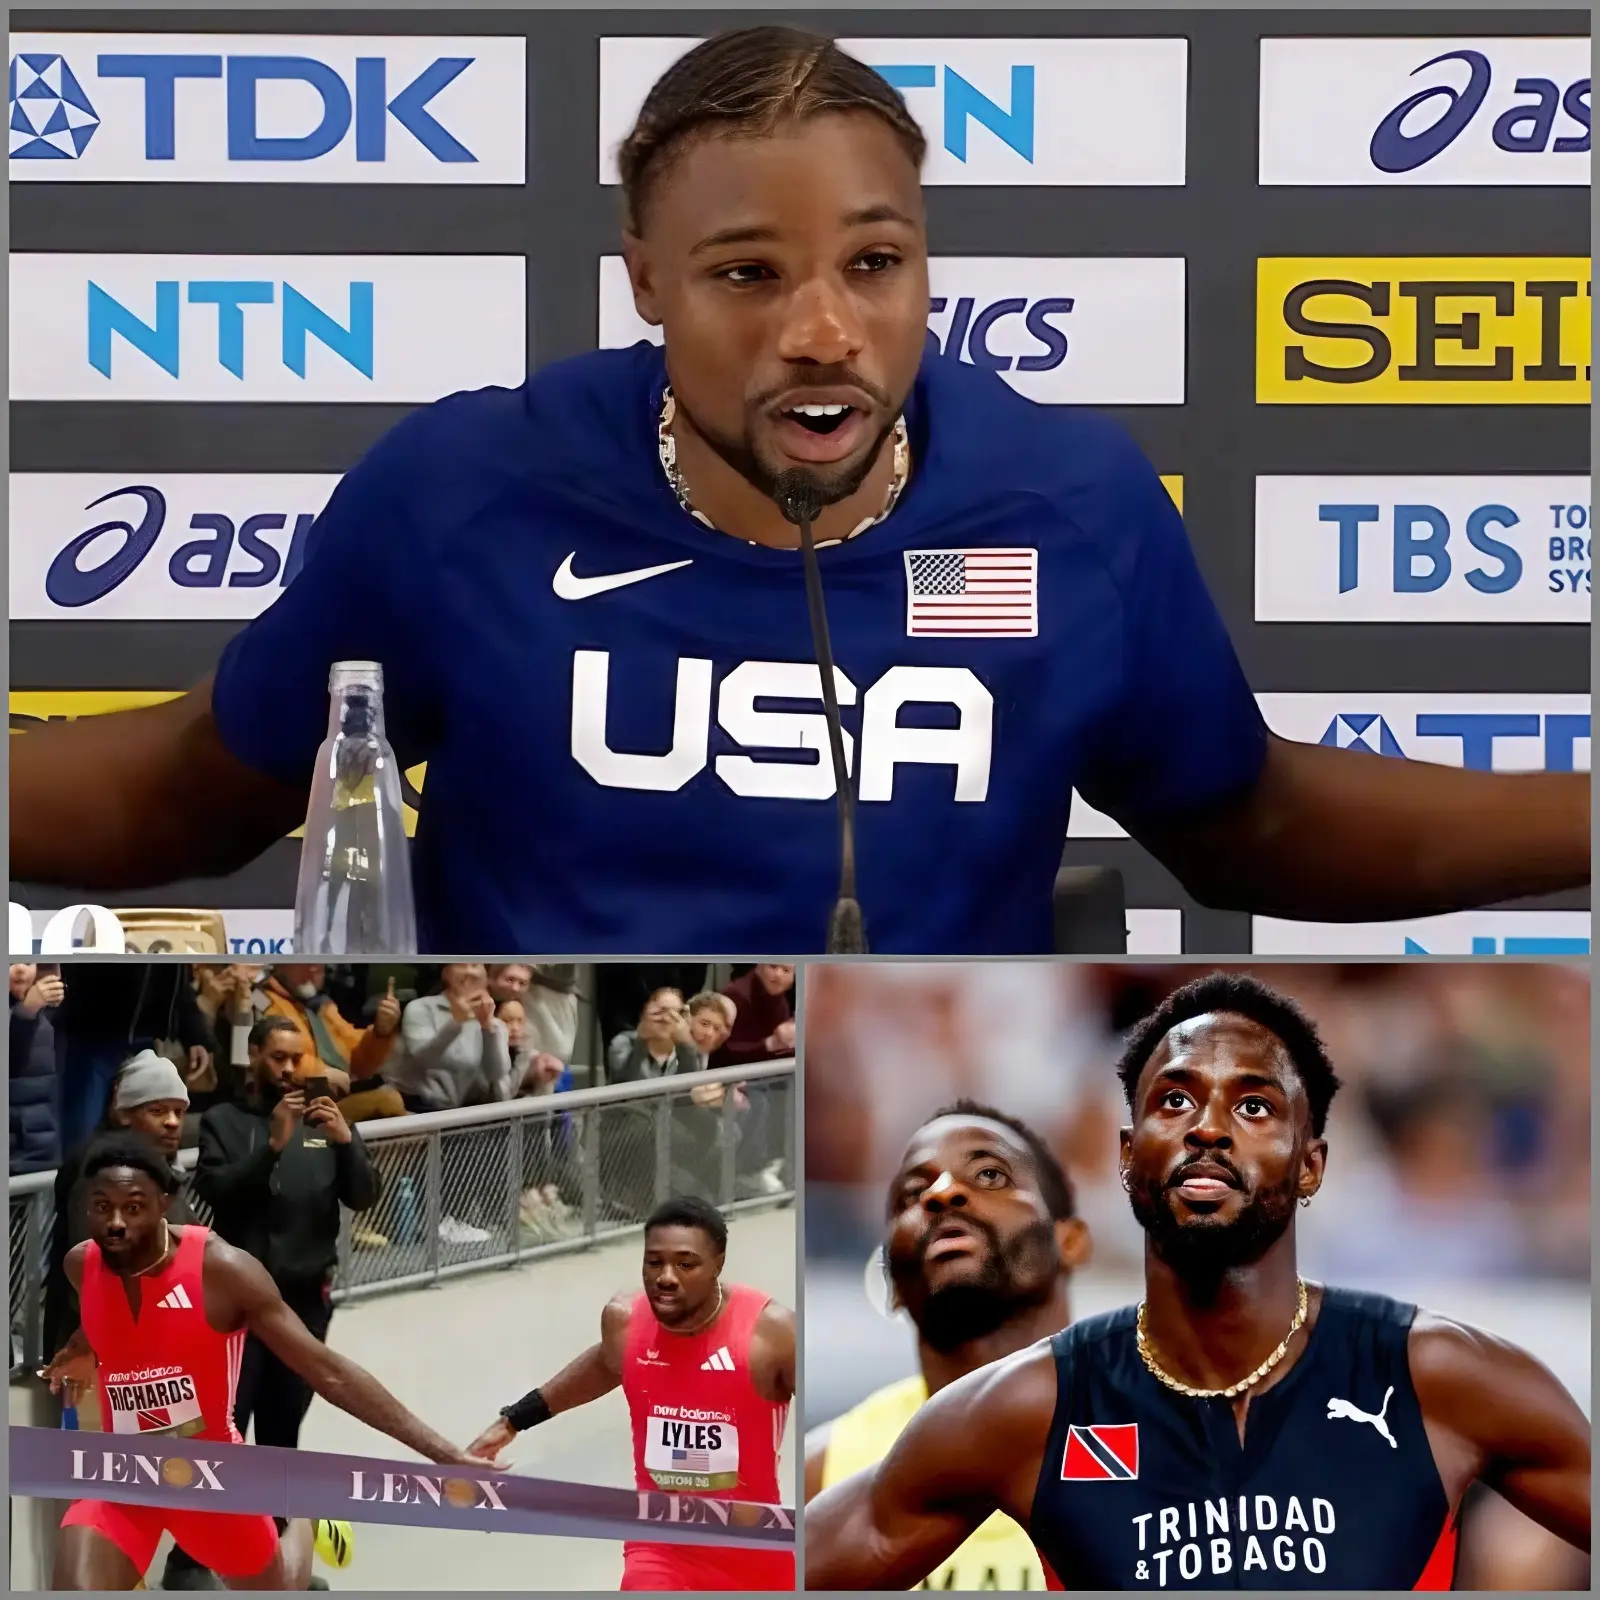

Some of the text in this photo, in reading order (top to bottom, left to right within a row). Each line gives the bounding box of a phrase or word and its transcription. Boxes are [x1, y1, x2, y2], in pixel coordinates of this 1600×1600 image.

[98, 54, 479, 162] TDK
[88, 280, 373, 380] NTN
[1283, 279, 1591, 384] SEI
[1549, 504, 1591, 529] TO
[1318, 504, 1523, 594] TBS
[1549, 536, 1591, 561] BR
[571, 649, 993, 802] USA
[229, 938, 295, 955] TOK
[107, 1377, 194, 1411] RICHARDS
[662, 1421, 722, 1450] LYLES
[71, 1449, 225, 1491] LENOX
[349, 1470, 508, 1511] LENOX
[1131, 1495, 1336, 1551] TRINIDAD
